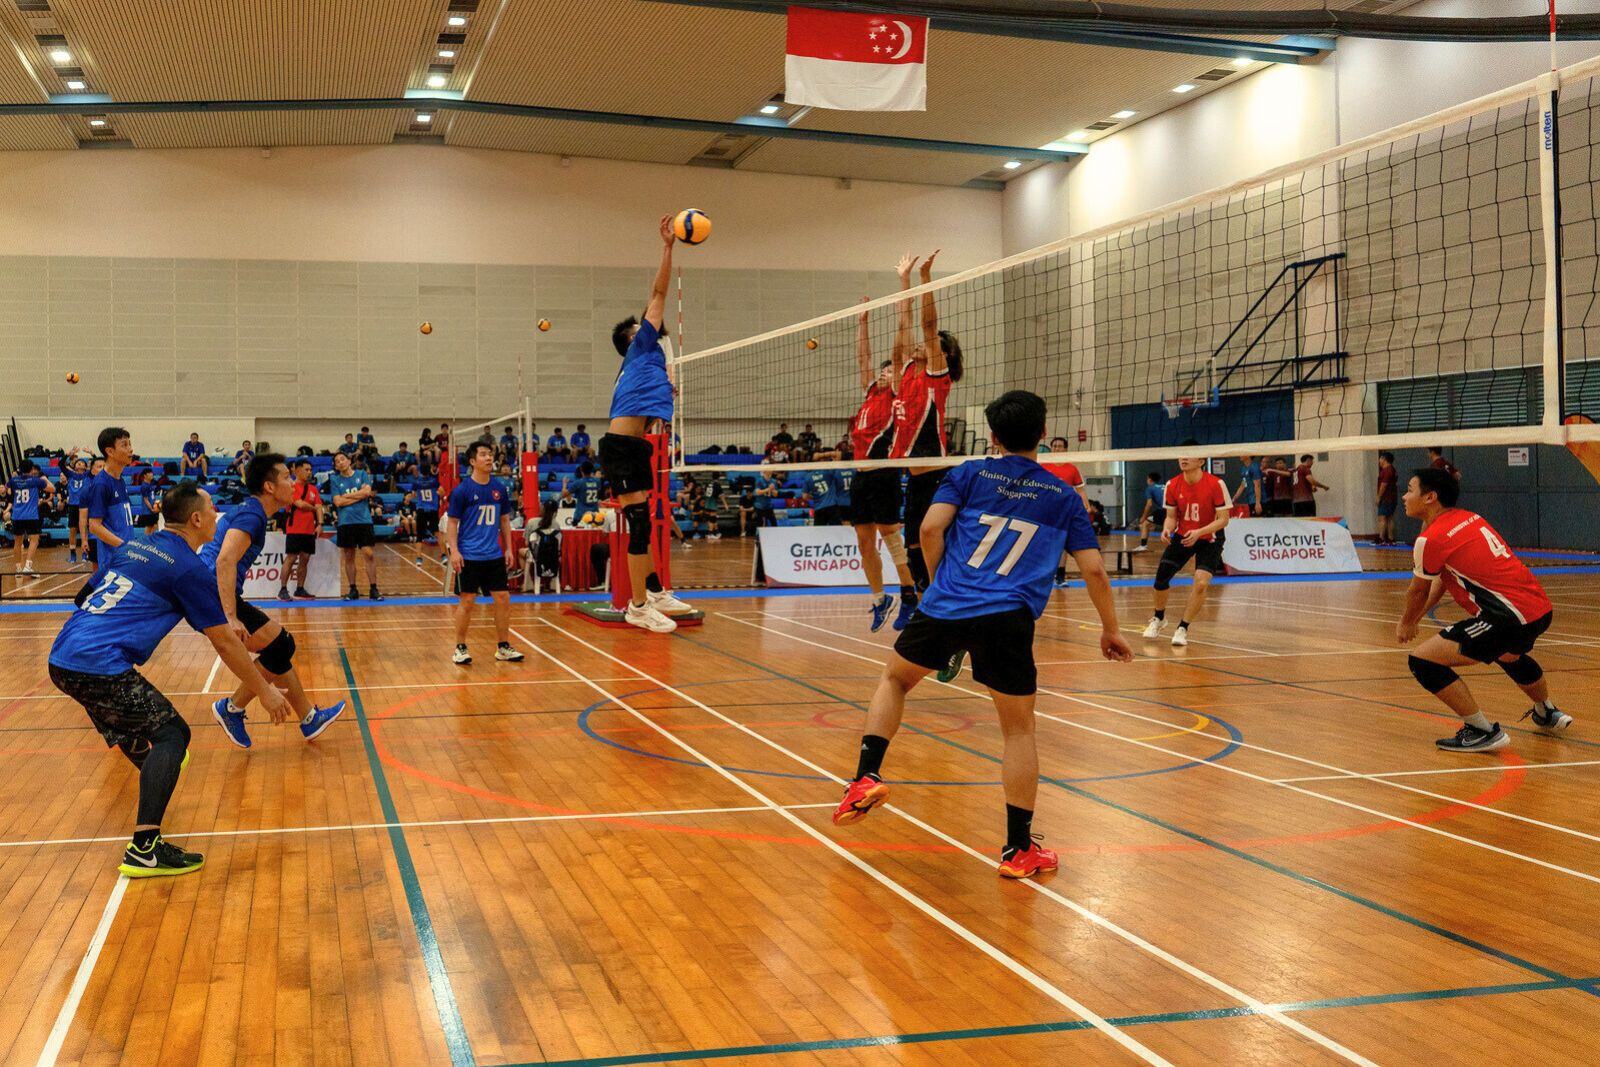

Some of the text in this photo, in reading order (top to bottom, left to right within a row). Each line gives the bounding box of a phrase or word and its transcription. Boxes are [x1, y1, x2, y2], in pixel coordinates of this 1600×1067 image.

[1543, 111, 1552, 150] molten
[16, 489, 30, 503] 28
[420, 489, 433, 502] 19
[586, 490, 598, 503] 22
[997, 486, 1038, 499] Singapore
[477, 504, 496, 526] 70
[1184, 503, 1200, 522] 18
[967, 513, 1040, 576] 77
[1480, 526, 1511, 558] 4
[1249, 548, 1326, 560] SINGAPORE
[793, 559, 864, 571] SINGAPO
